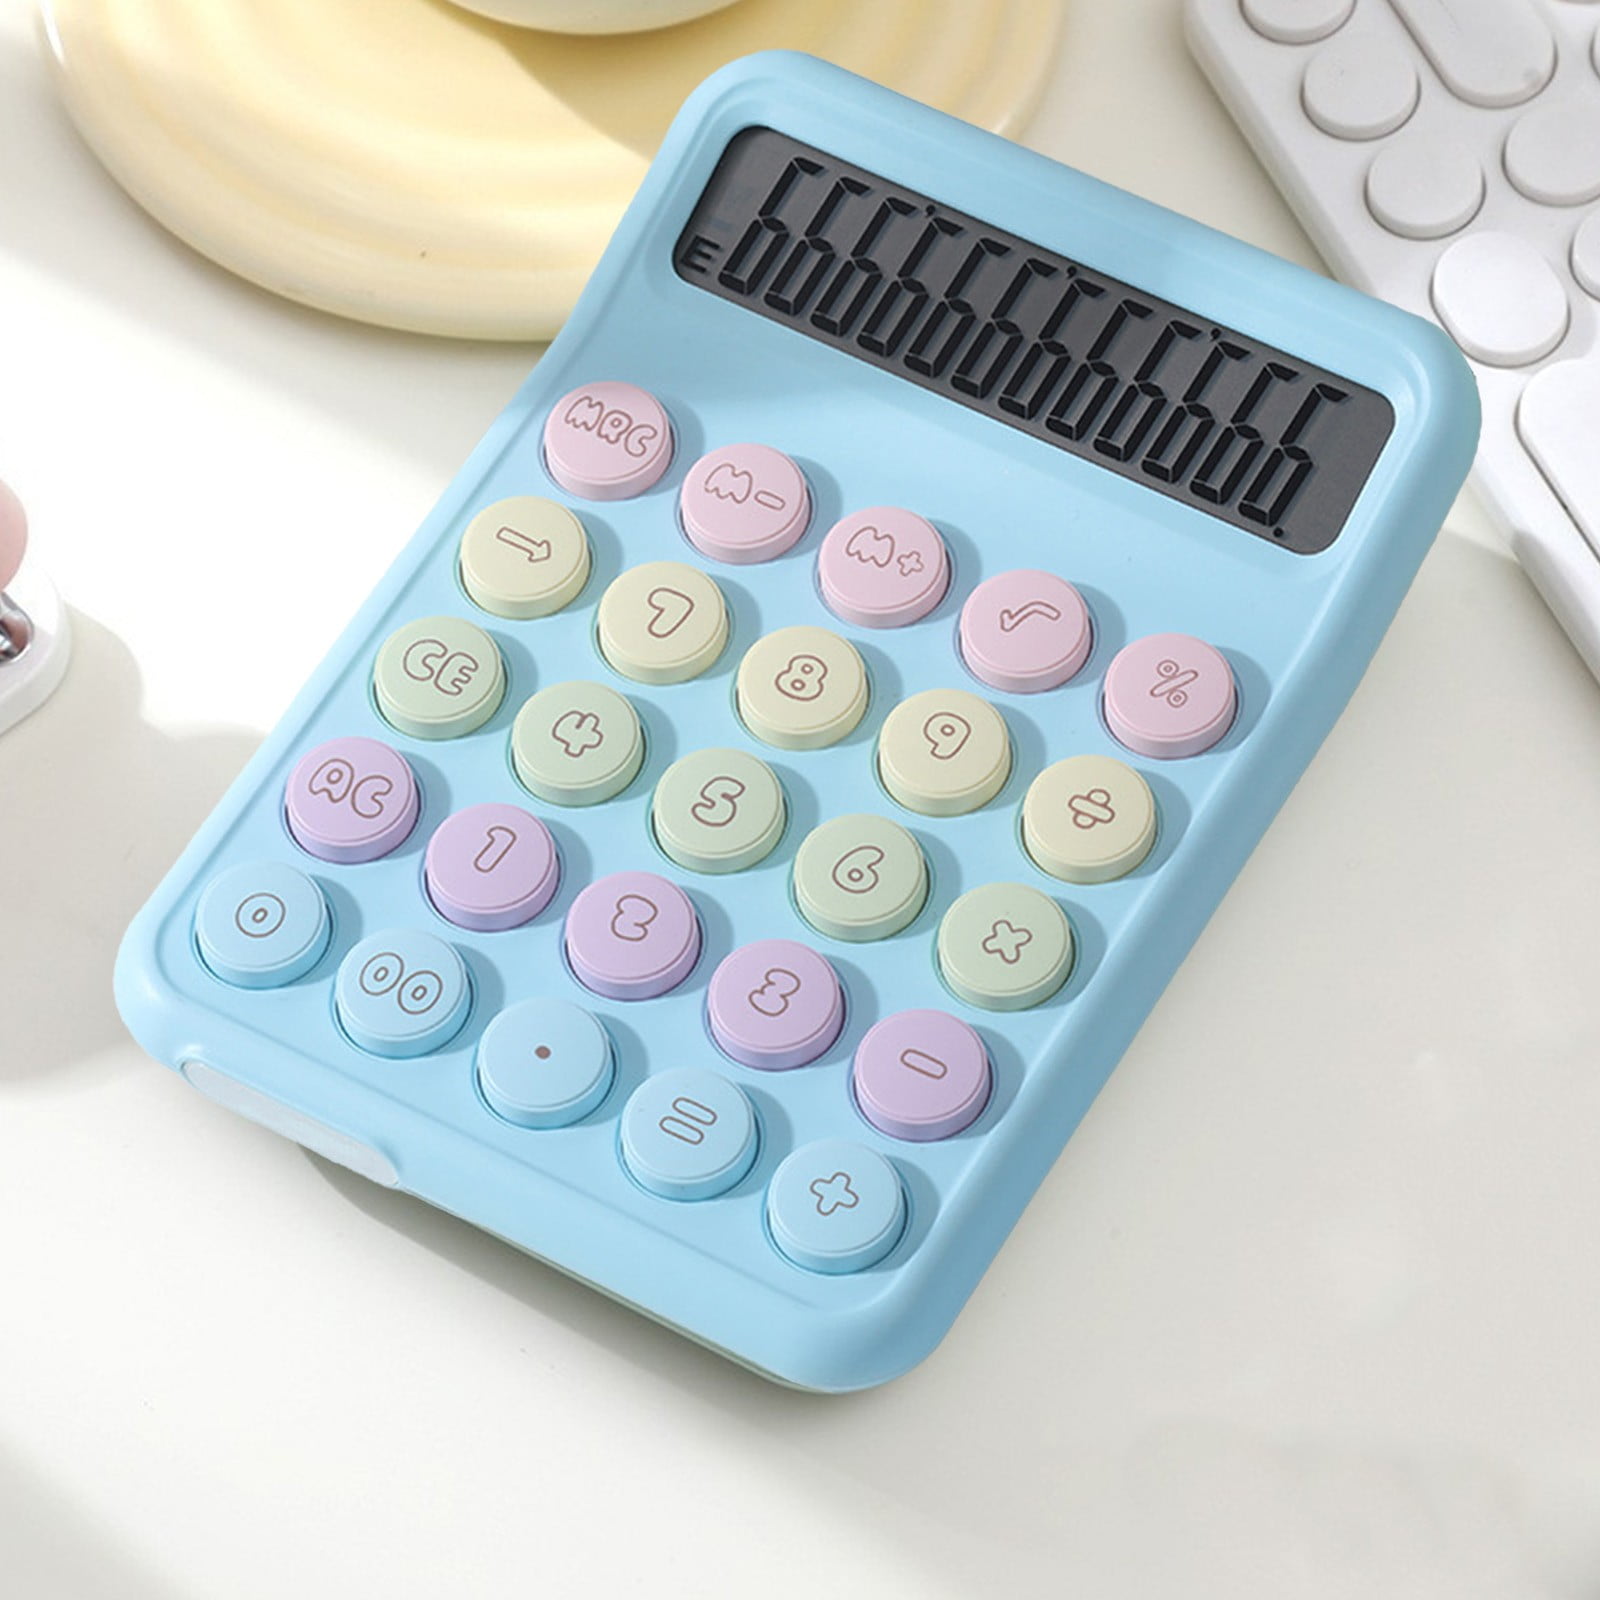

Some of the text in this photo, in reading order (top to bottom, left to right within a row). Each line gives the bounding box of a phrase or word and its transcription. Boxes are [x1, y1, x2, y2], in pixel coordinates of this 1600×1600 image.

[680, 235, 721, 274] E
[565, 396, 657, 457] MRC
[846, 526, 924, 576] M+
[647, 587, 694, 638] 7
[403, 639, 478, 696] CE
[775, 655, 828, 701] 8
[1149, 660, 1198, 708] %
[552, 711, 603, 757] 4
[923, 712, 971, 760] 9
[309, 758, 393, 818] AC
[691, 777, 745, 827] 5
[474, 825, 516, 873] 1
[832, 846, 884, 893] 6
[235, 893, 286, 938] 0
[359, 952, 443, 1015] 00
[748, 968, 801, 1016] 3
[659, 1097, 717, 1145] =
